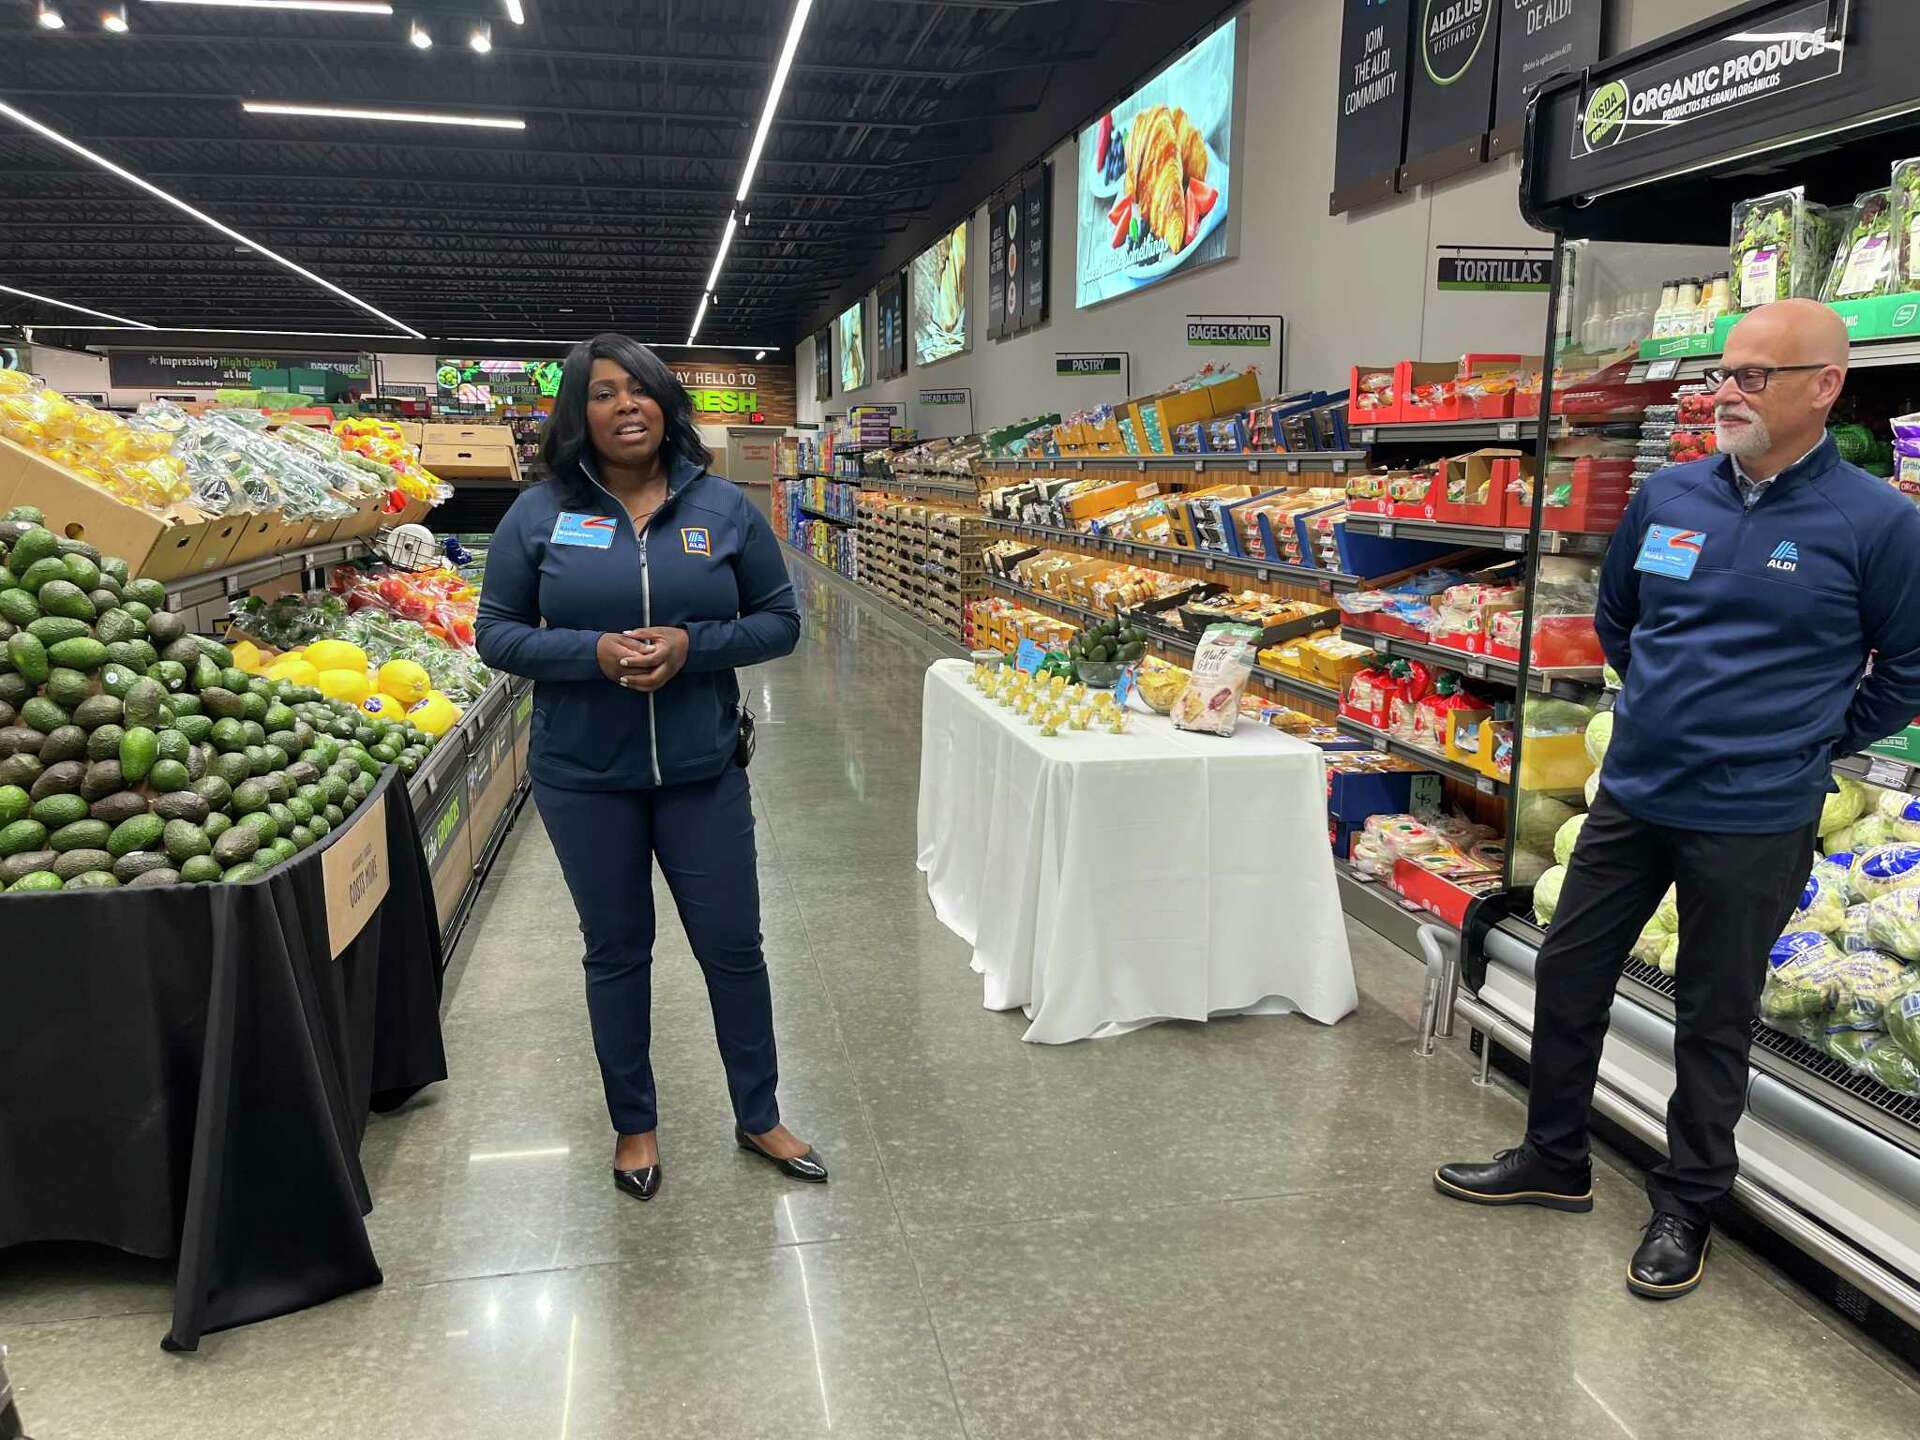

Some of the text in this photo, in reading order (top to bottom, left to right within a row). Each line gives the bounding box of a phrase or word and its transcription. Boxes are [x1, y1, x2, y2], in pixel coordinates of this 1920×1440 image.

[1527, 0, 1571, 35] DE ALDI
[1364, 25, 1384, 58] JOIN
[1354, 48, 1391, 85] THE ALDI
[1632, 27, 1827, 116] ORGANIC PRODUCE
[1345, 71, 1397, 115] COMMUNITY
[1592, 92, 1617, 119] USDA
[1662, 72, 1780, 121] PRODUCTOS DE GRANJA ORGÁNICOS
[1455, 260, 1542, 283] TORTILLAS
[159, 356, 278, 370] Impressively High Quality
[235, 370, 252, 381] Imp
[1072, 359, 1105, 372] PASTRY
[676, 371, 756, 386] AY HELLO TO
[687, 390, 757, 412] RESH
[1767, 558, 1797, 572] ALDI
